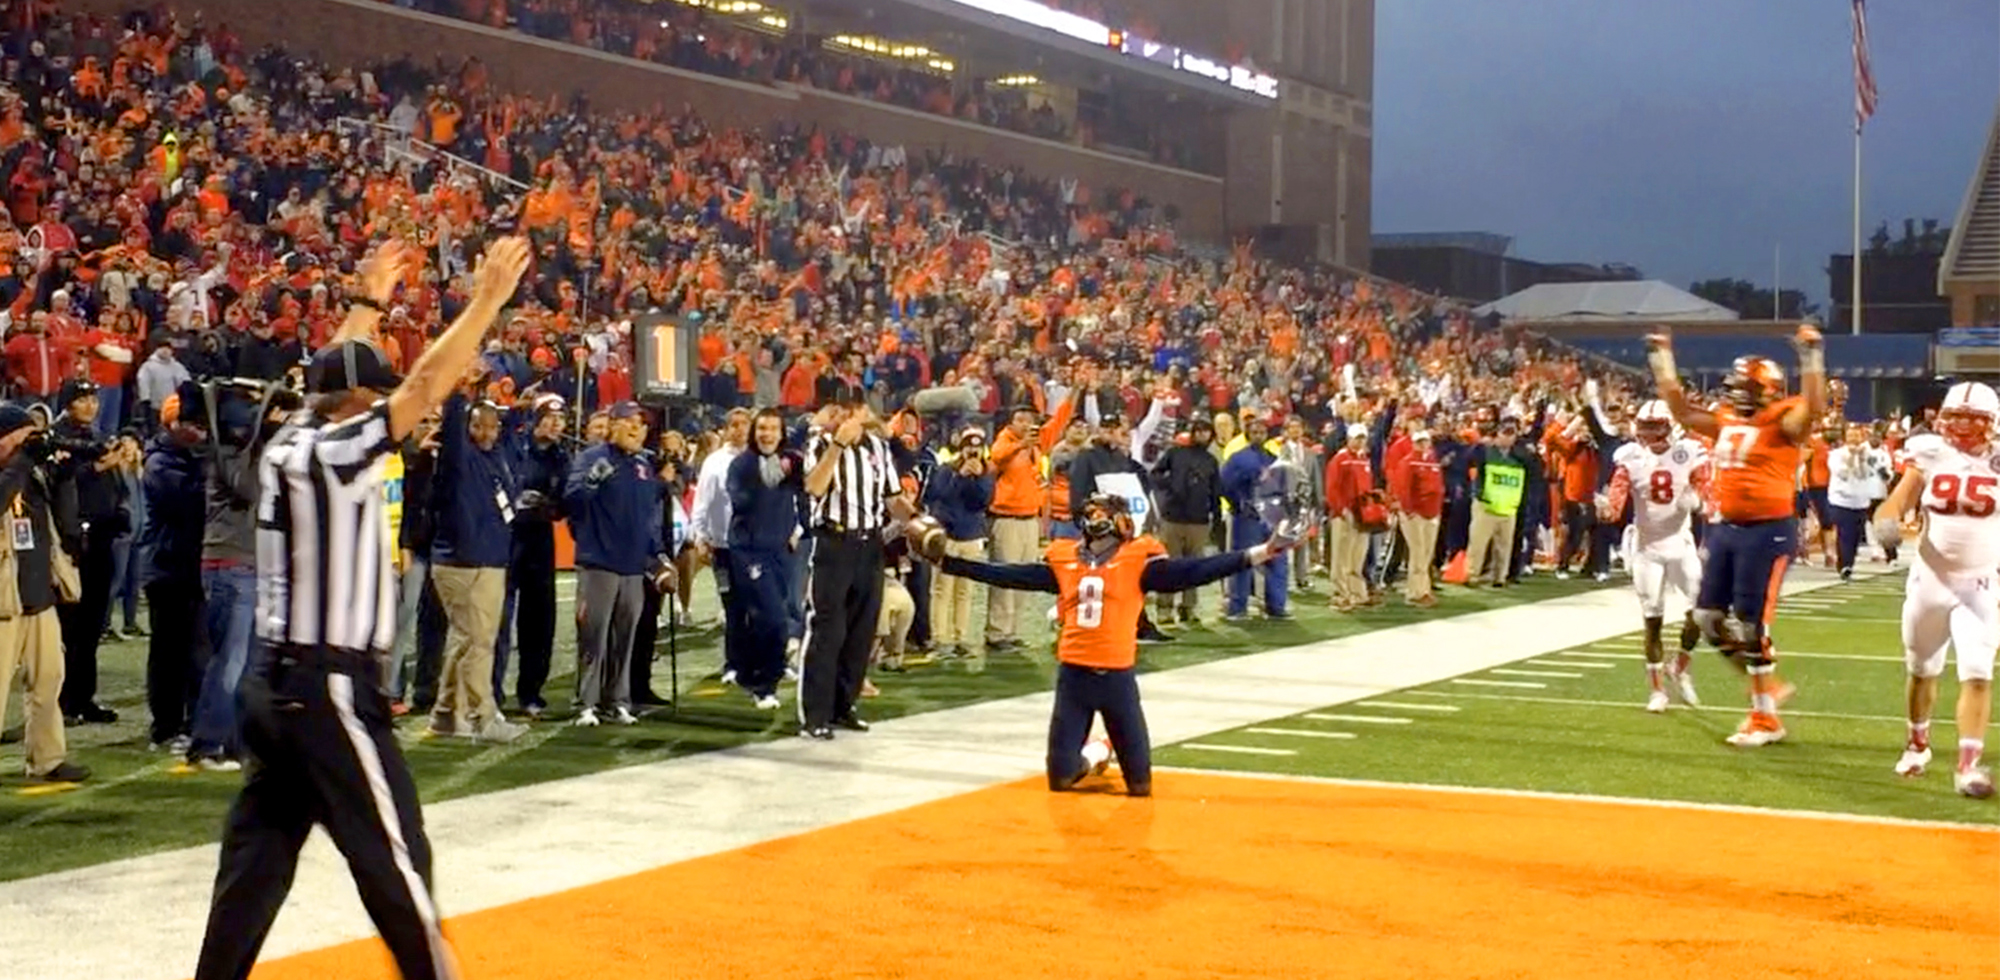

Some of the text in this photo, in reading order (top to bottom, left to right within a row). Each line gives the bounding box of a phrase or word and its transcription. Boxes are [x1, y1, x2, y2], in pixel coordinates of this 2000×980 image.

[653, 325, 676, 382] 1
[1650, 470, 1674, 505] 8
[1928, 473, 1998, 519] 95
[1077, 576, 1104, 628] 8
[1975, 577, 1989, 591] N
